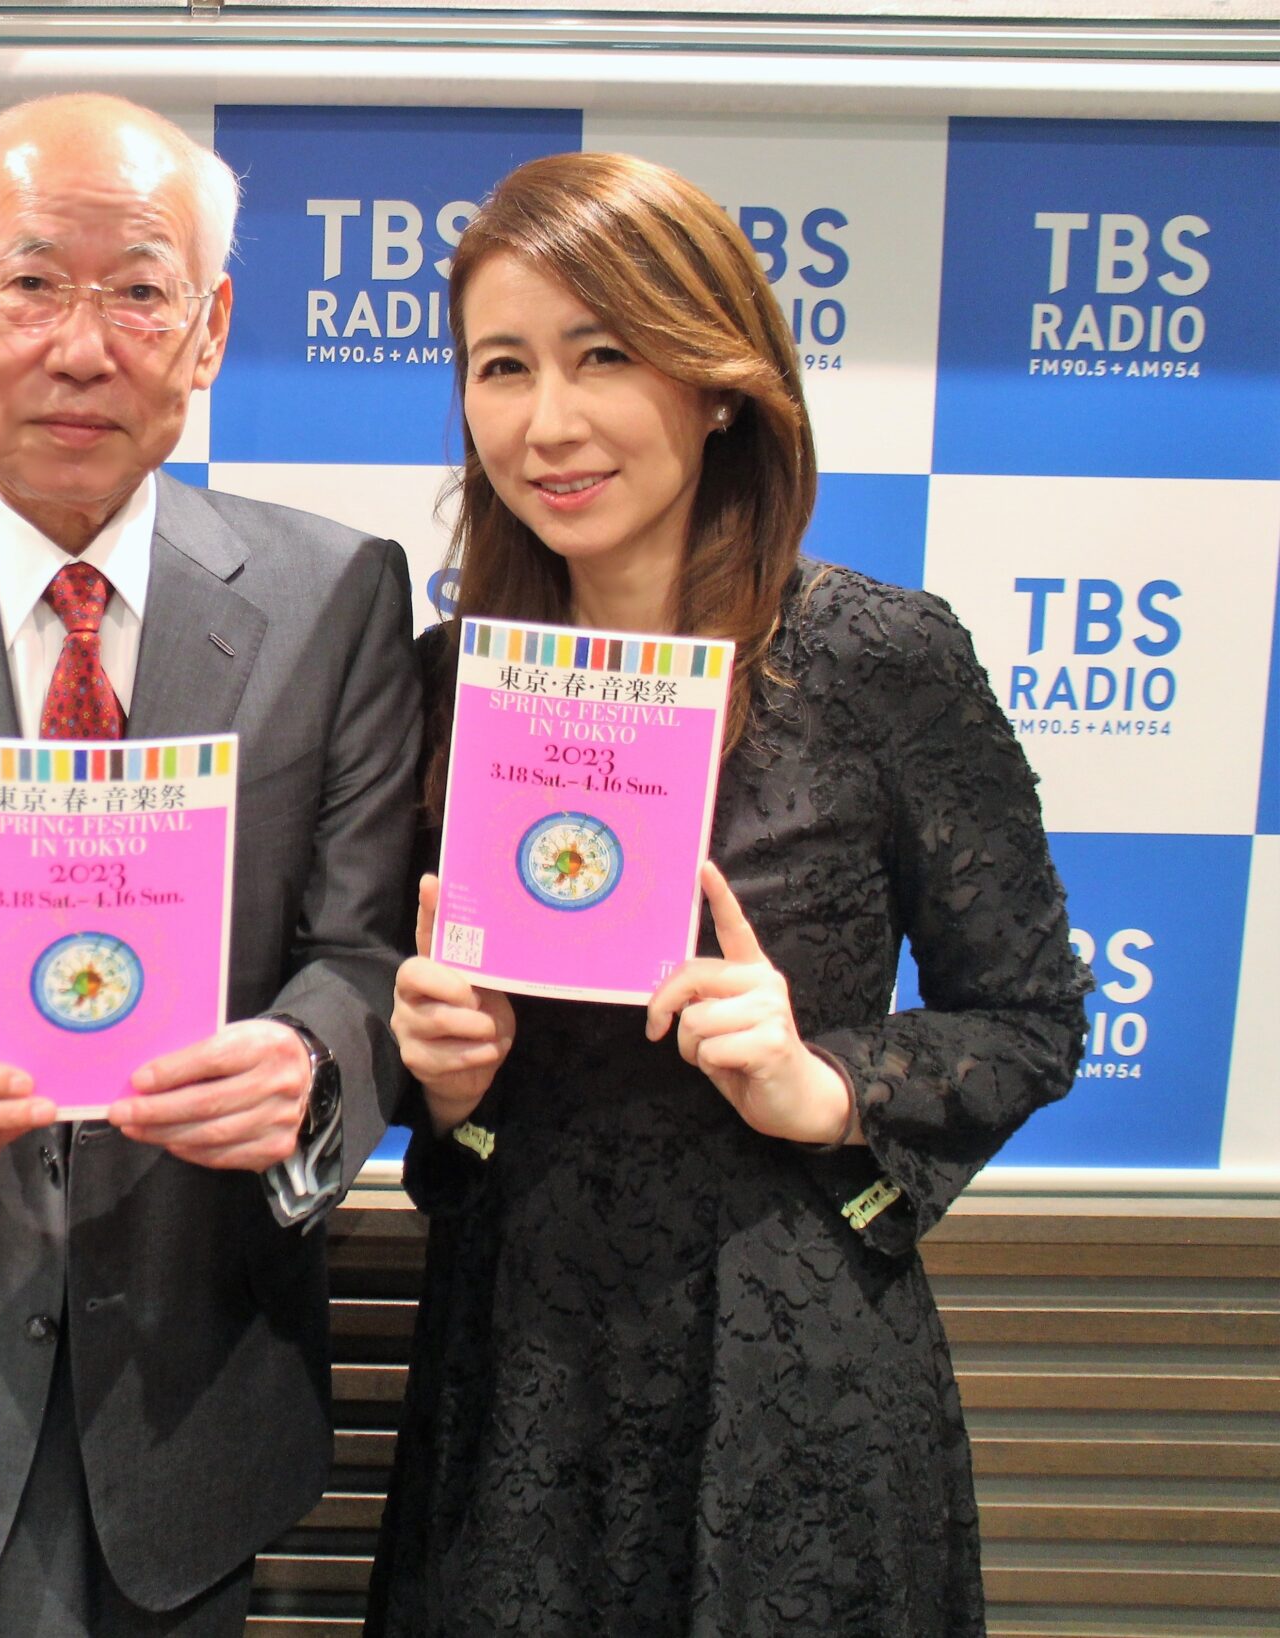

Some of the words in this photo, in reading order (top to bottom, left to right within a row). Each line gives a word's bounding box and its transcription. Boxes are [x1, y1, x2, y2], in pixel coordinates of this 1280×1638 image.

[738, 206, 849, 288] BS
[1034, 212, 1211, 296] TBS
[307, 290, 452, 339] RADI
[1030, 303, 1206, 353] RADIO
[306, 346, 454, 364] FM90.5+AM9
[1014, 577, 1182, 657] TBS
[1008, 666, 1176, 712] RADIO
[489, 691, 570, 719] SPRING
[578, 701, 680, 727] FESTIVAL
[528, 717, 553, 737] IN
[560, 720, 636, 744] TOKYO
[544, 744, 616, 776] 2023
[490, 762, 528, 784] 3.18
[626, 776, 668, 796] Sun.
[81, 811, 192, 836] FESTIVAL
[30, 838, 57, 858] IN
[63, 837, 148, 858] TOKYO
[49, 863, 127, 890] 2023
[140, 888, 185, 905] Sun.
